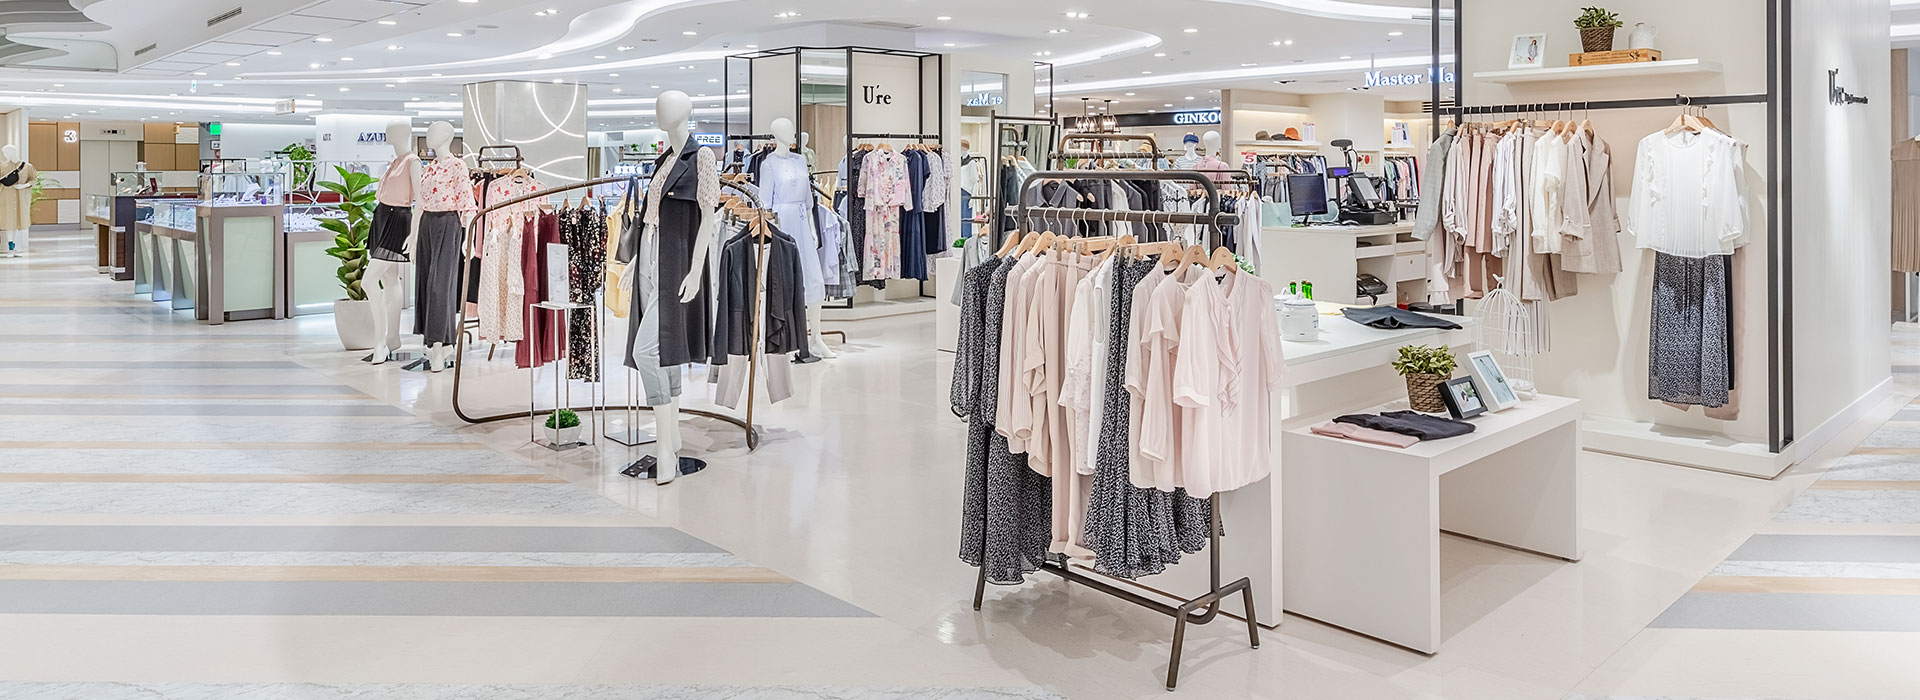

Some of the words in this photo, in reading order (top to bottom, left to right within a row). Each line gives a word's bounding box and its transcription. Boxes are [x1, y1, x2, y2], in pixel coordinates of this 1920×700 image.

[1364, 70, 1423, 88] Master
[1173, 111, 1222, 124] GINKO
[63, 129, 77, 143] 3
[357, 132, 387, 142] AZU
[696, 135, 721, 144] FREE
